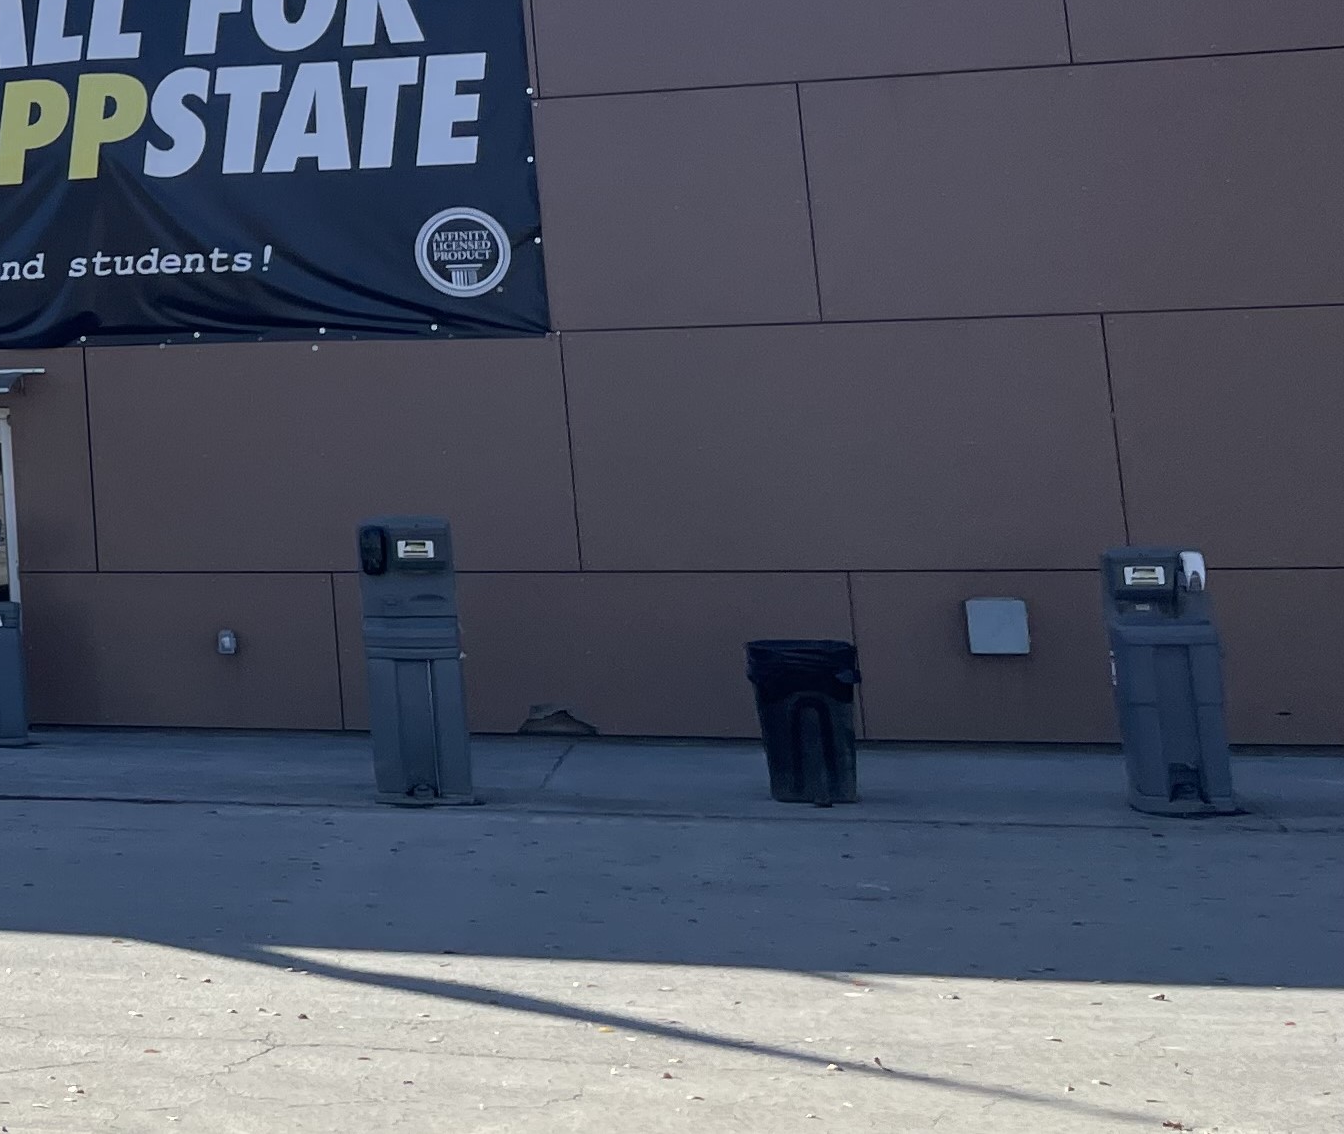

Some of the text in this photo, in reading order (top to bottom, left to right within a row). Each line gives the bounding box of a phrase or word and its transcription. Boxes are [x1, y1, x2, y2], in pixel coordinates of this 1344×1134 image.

[433, 230, 489, 241] AFFINITY
[432, 241, 491, 251] LICENSED
[433, 250, 492, 261] PRODUCT
[67, 245, 273, 278] students!
